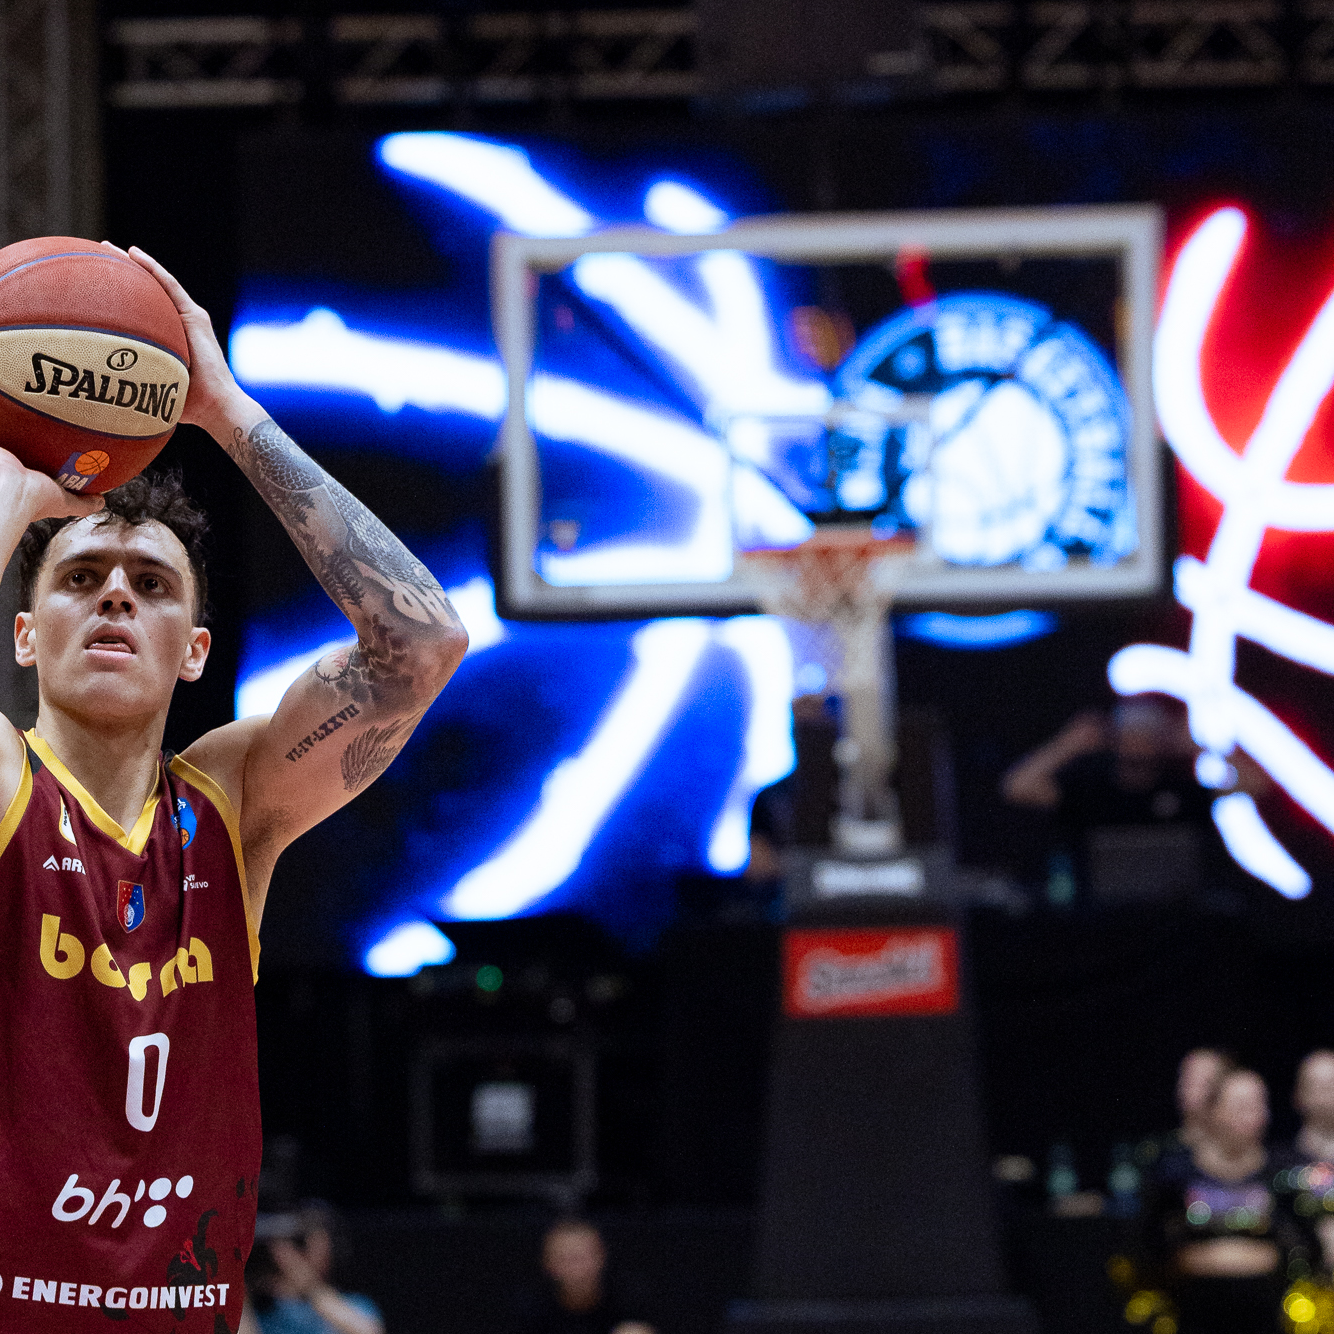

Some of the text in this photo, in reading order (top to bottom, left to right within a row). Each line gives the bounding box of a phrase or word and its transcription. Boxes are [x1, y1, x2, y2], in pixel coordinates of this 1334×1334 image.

[24, 352, 179, 423] SPALDING
[125, 1032, 171, 1133] 0
[11, 1275, 231, 1310] ENERGOINVEST
